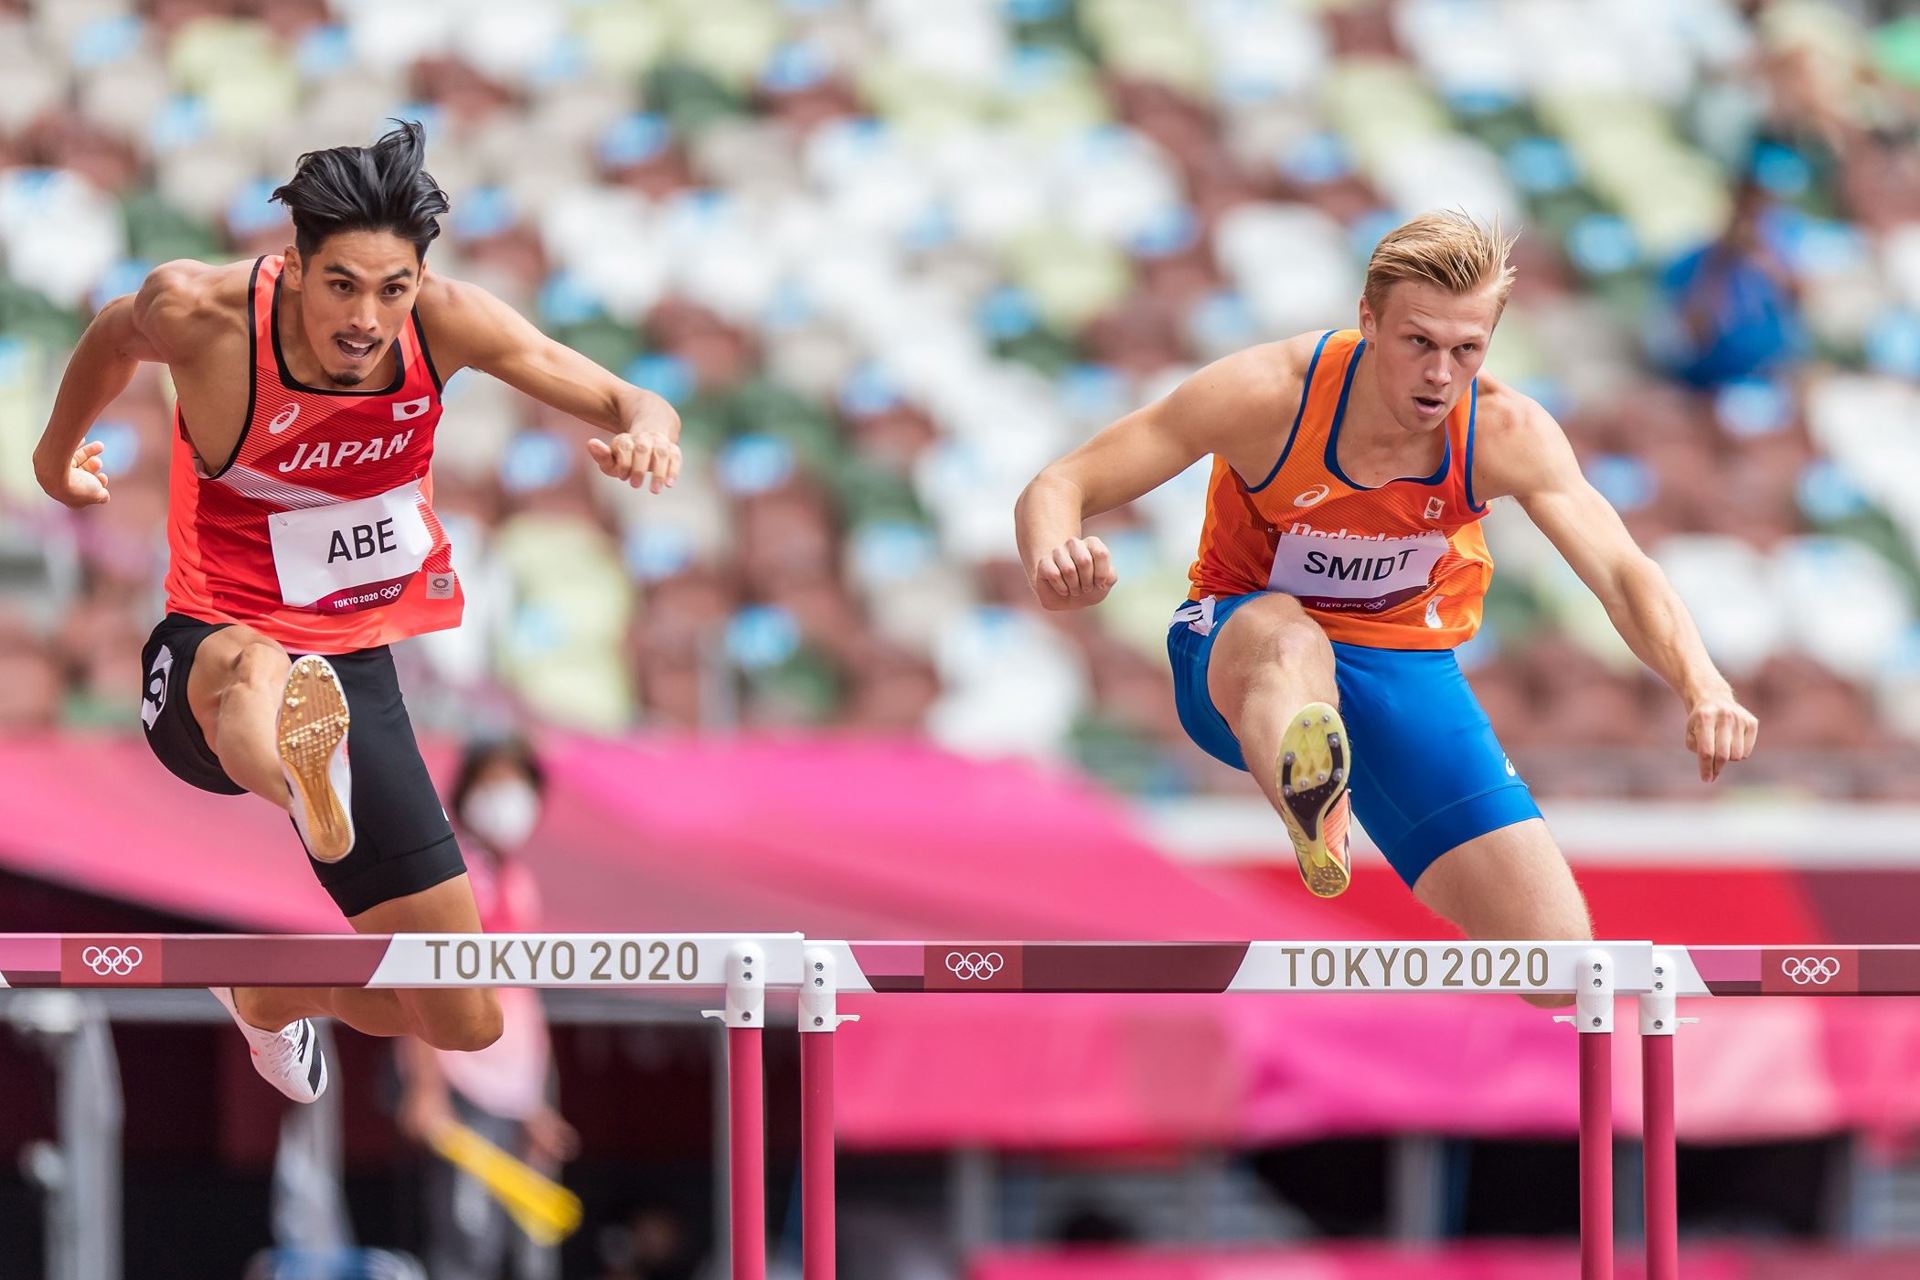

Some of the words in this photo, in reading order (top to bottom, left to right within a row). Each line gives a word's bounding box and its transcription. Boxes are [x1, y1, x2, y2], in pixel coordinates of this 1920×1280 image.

[278, 428, 415, 473] JAPAN
[327, 517, 397, 564] ABE
[1303, 549, 1418, 581] SMIDT
[333, 596, 359, 609] TOKYO
[359, 592, 379, 603] 2020
[425, 940, 575, 980] TOKYO
[590, 940, 698, 980] 2020
[1281, 947, 1428, 987] TOKYO
[1442, 947, 1549, 987] 2020
